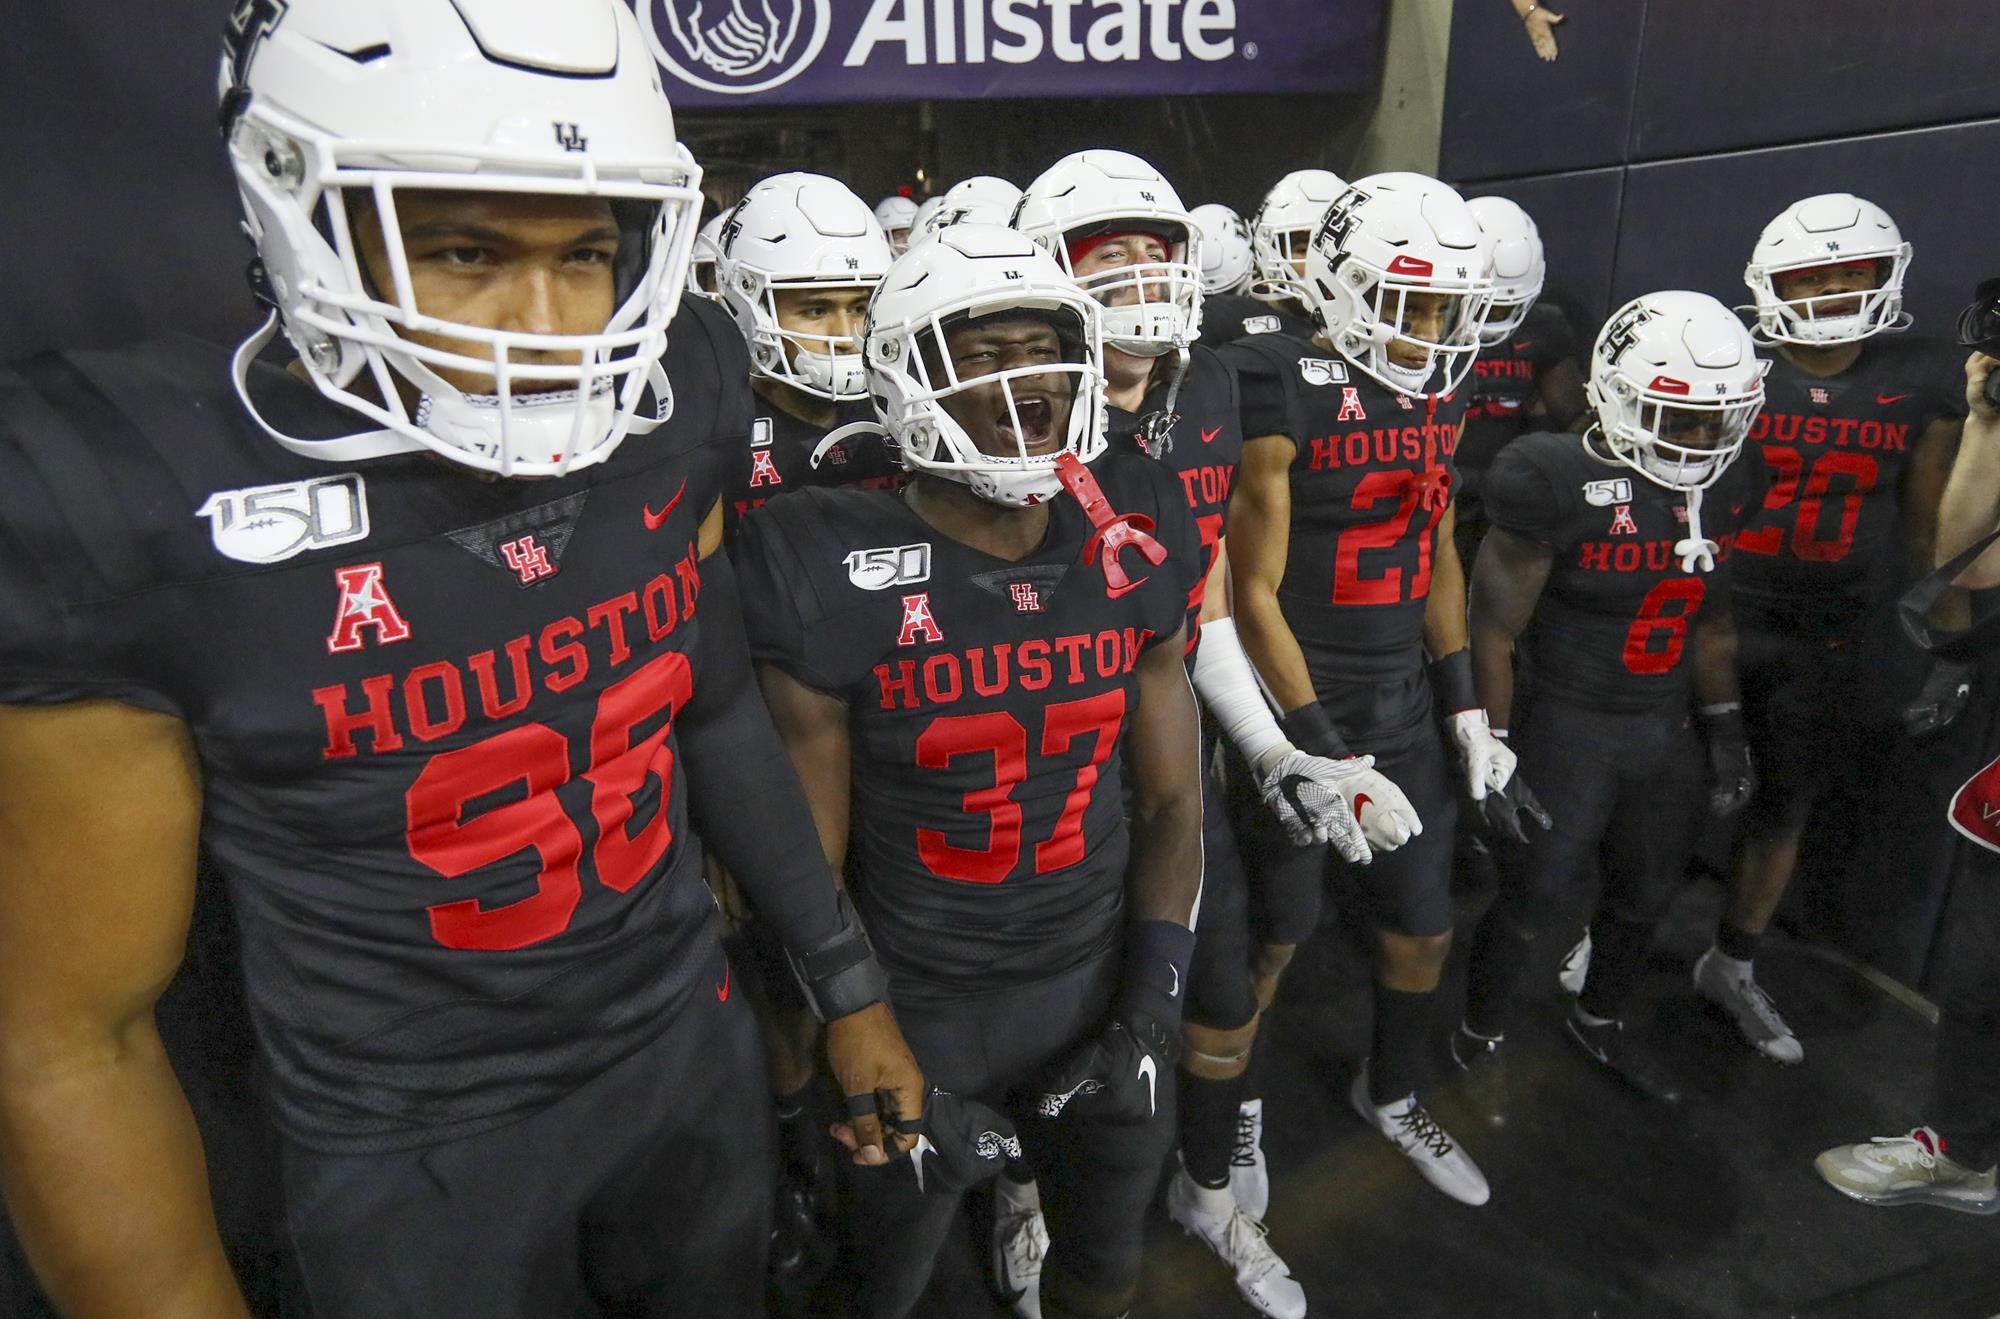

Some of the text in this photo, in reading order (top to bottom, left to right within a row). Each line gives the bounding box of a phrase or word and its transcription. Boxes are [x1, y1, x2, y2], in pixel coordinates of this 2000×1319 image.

[843, 0, 1237, 67] Allstate
[1748, 412, 1909, 452] OUSTON
[196, 472, 371, 565] 150
[842, 543, 932, 591] 150
[312, 541, 701, 760] HOUSTON
[873, 627, 1156, 710] HOUSTON
[1622, 577, 1706, 675] 8
[916, 688, 1126, 884] 37
